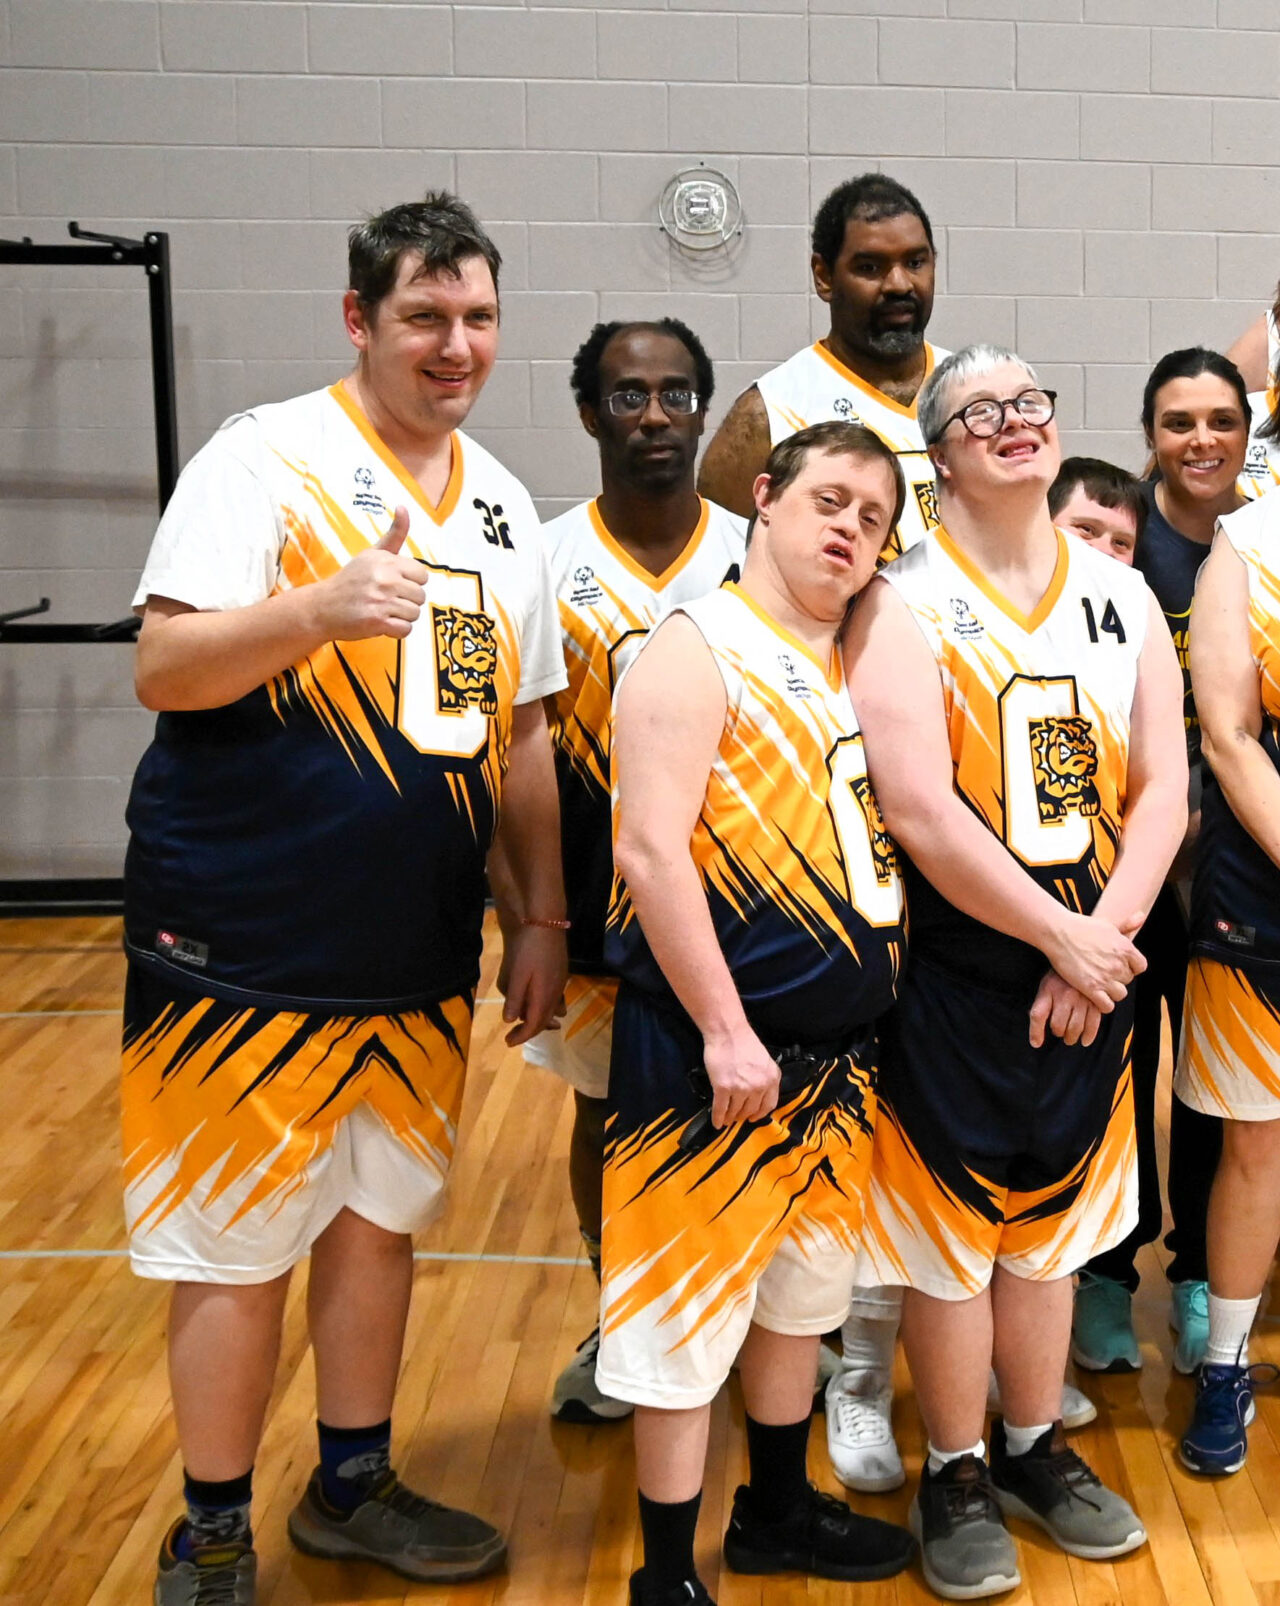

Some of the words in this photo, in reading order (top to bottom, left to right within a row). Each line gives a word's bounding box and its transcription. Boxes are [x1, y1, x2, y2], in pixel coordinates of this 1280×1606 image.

[473, 498, 515, 550] 32
[1081, 597, 1127, 644] 14
[997, 672, 1094, 867] C
